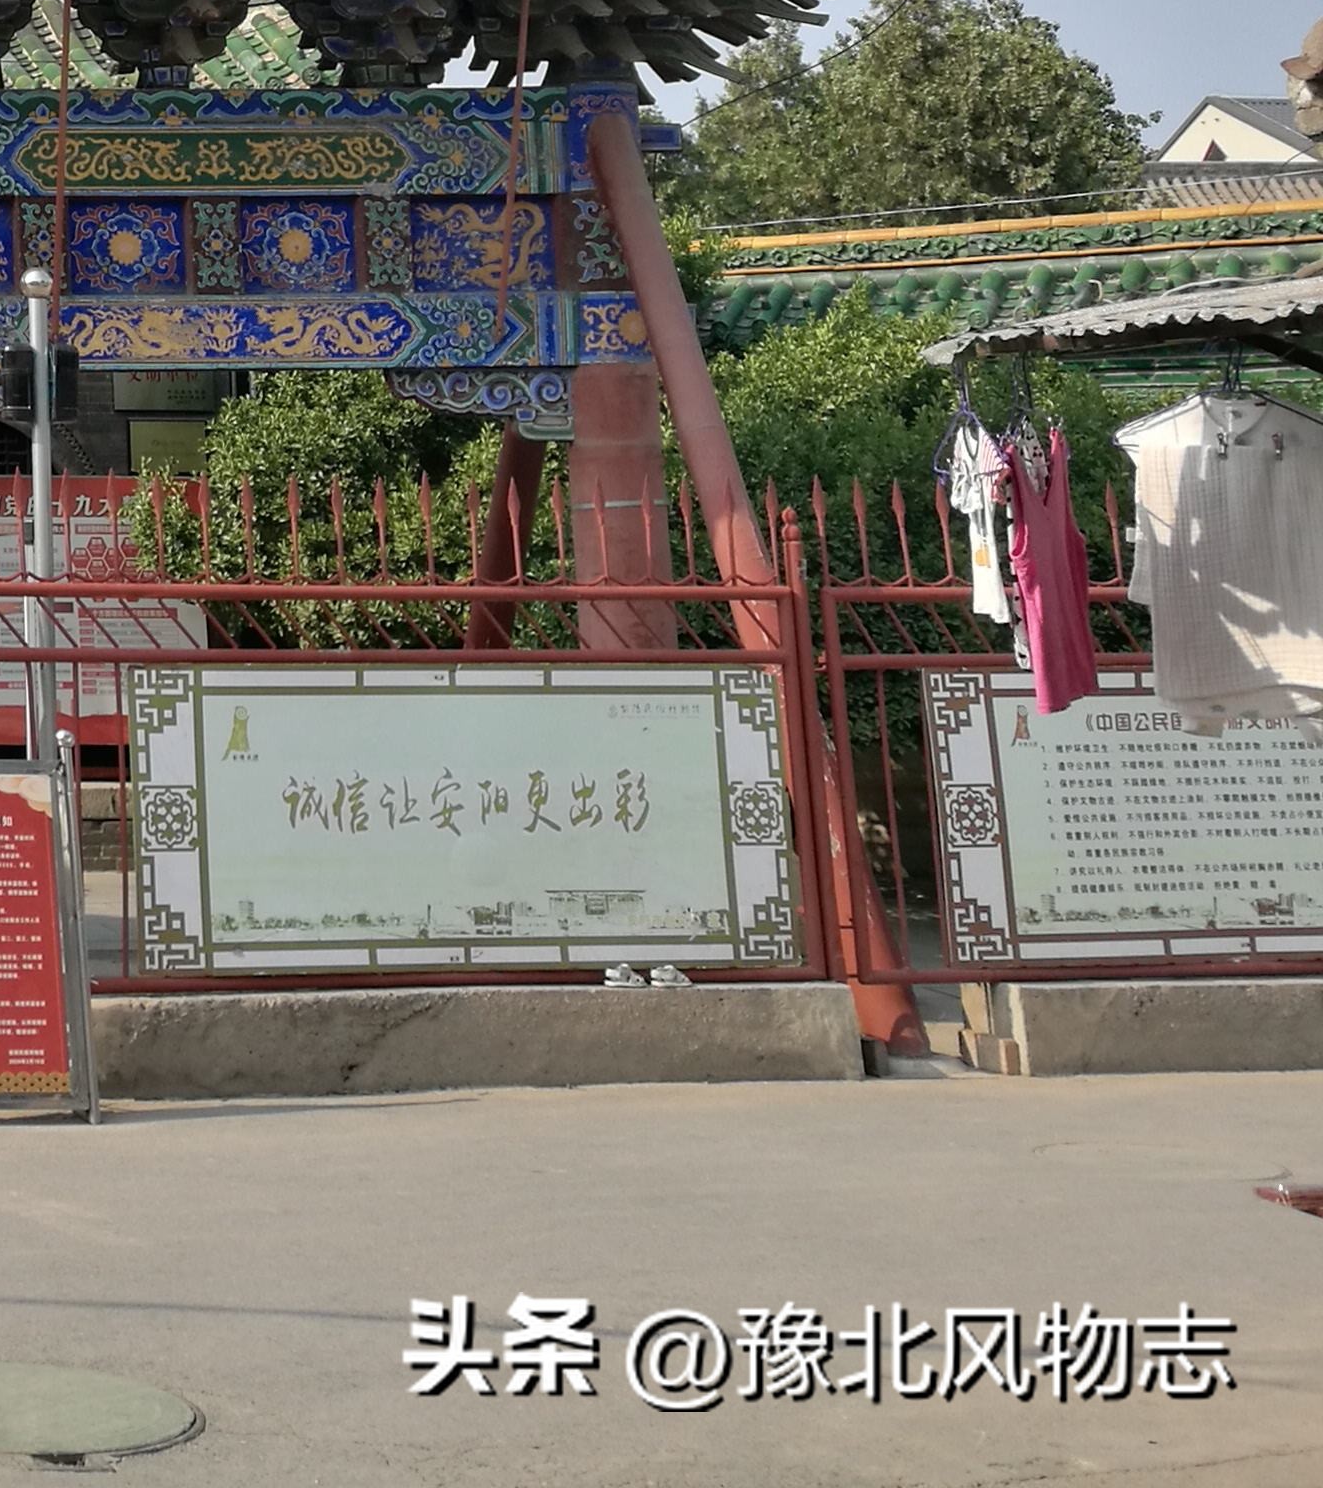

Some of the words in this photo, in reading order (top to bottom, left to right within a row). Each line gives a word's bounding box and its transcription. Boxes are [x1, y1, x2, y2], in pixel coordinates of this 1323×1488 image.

[281, 767, 653, 836] 诚信让安阳更出彩
